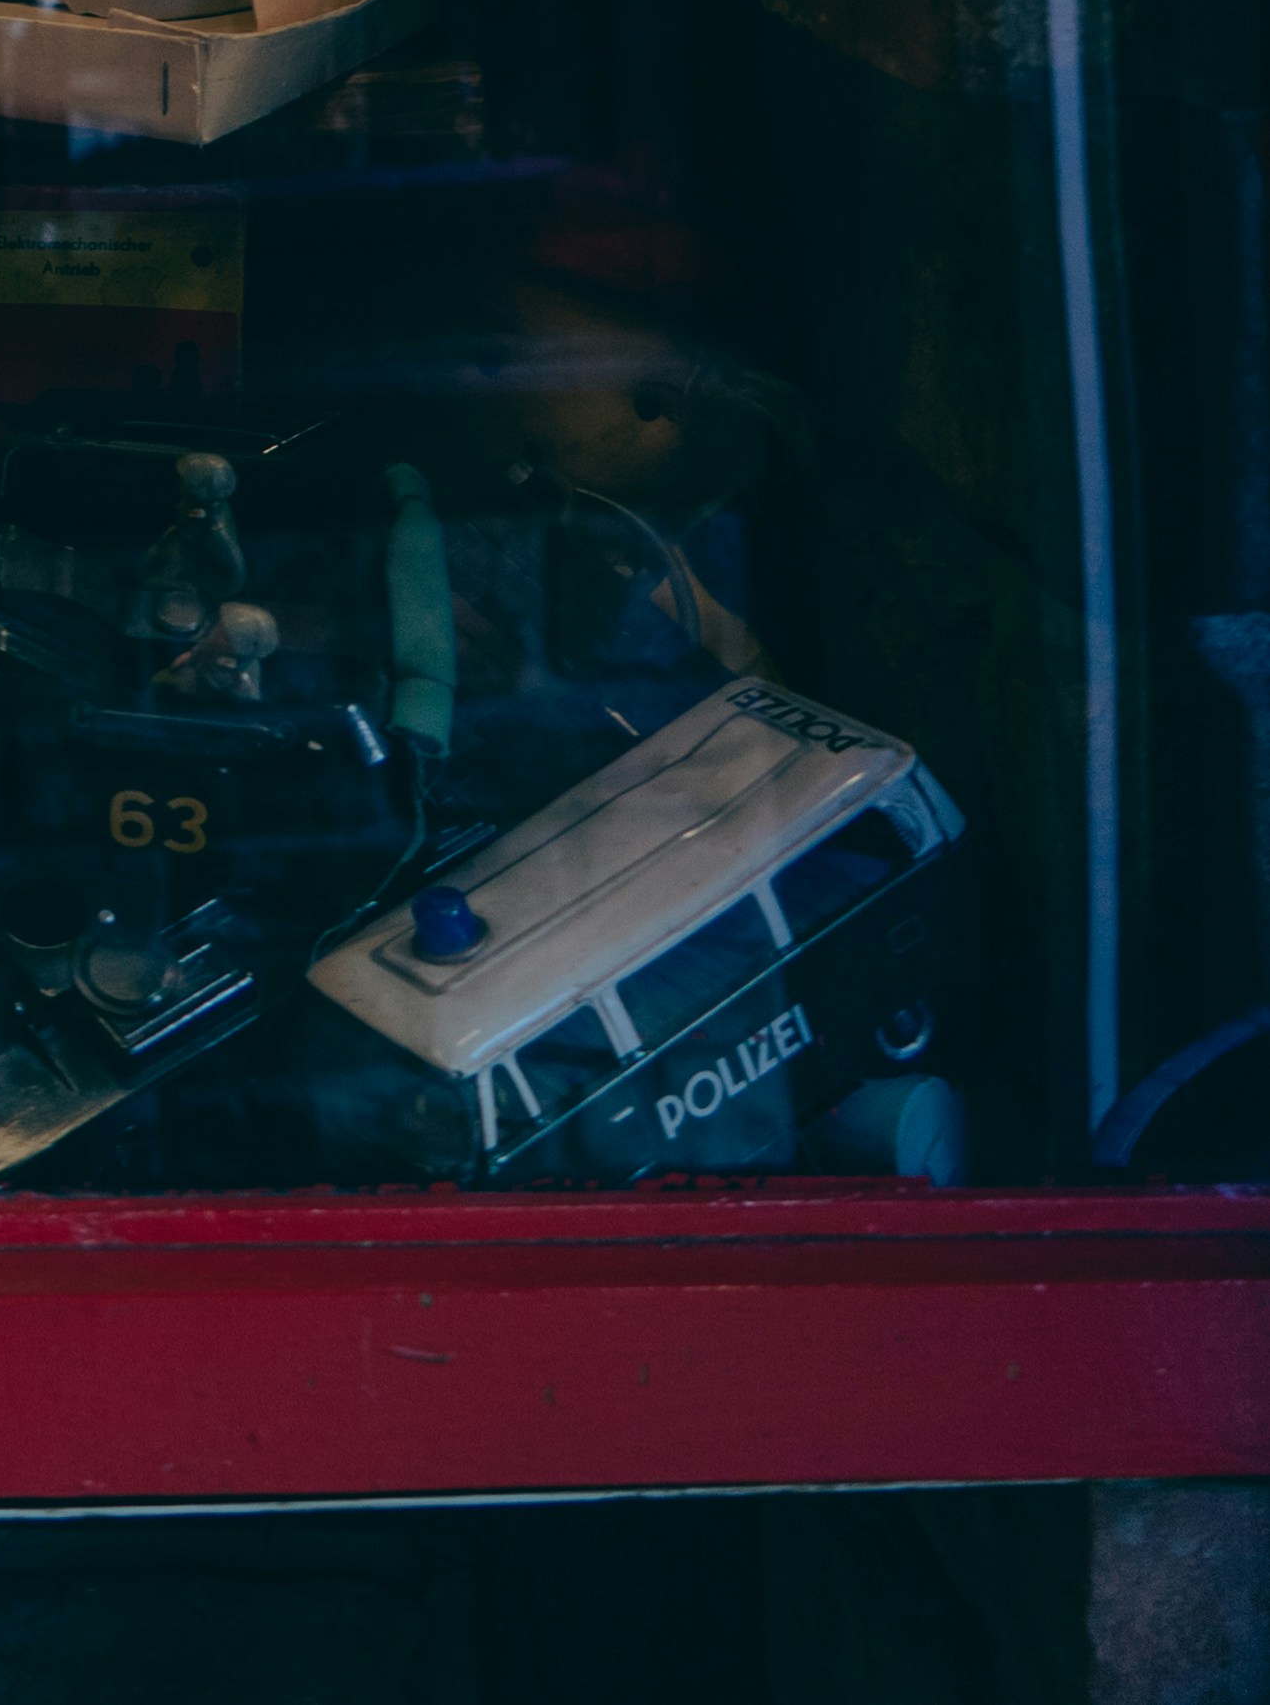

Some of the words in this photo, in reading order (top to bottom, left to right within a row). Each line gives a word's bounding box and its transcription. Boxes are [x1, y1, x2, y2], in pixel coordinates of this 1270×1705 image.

[41, 259, 101, 276] Antrieb
[724, 686, 864, 756] POLIZEI
[108, 789, 209, 854] 63
[653, 1002, 814, 1140] POLIZEI
